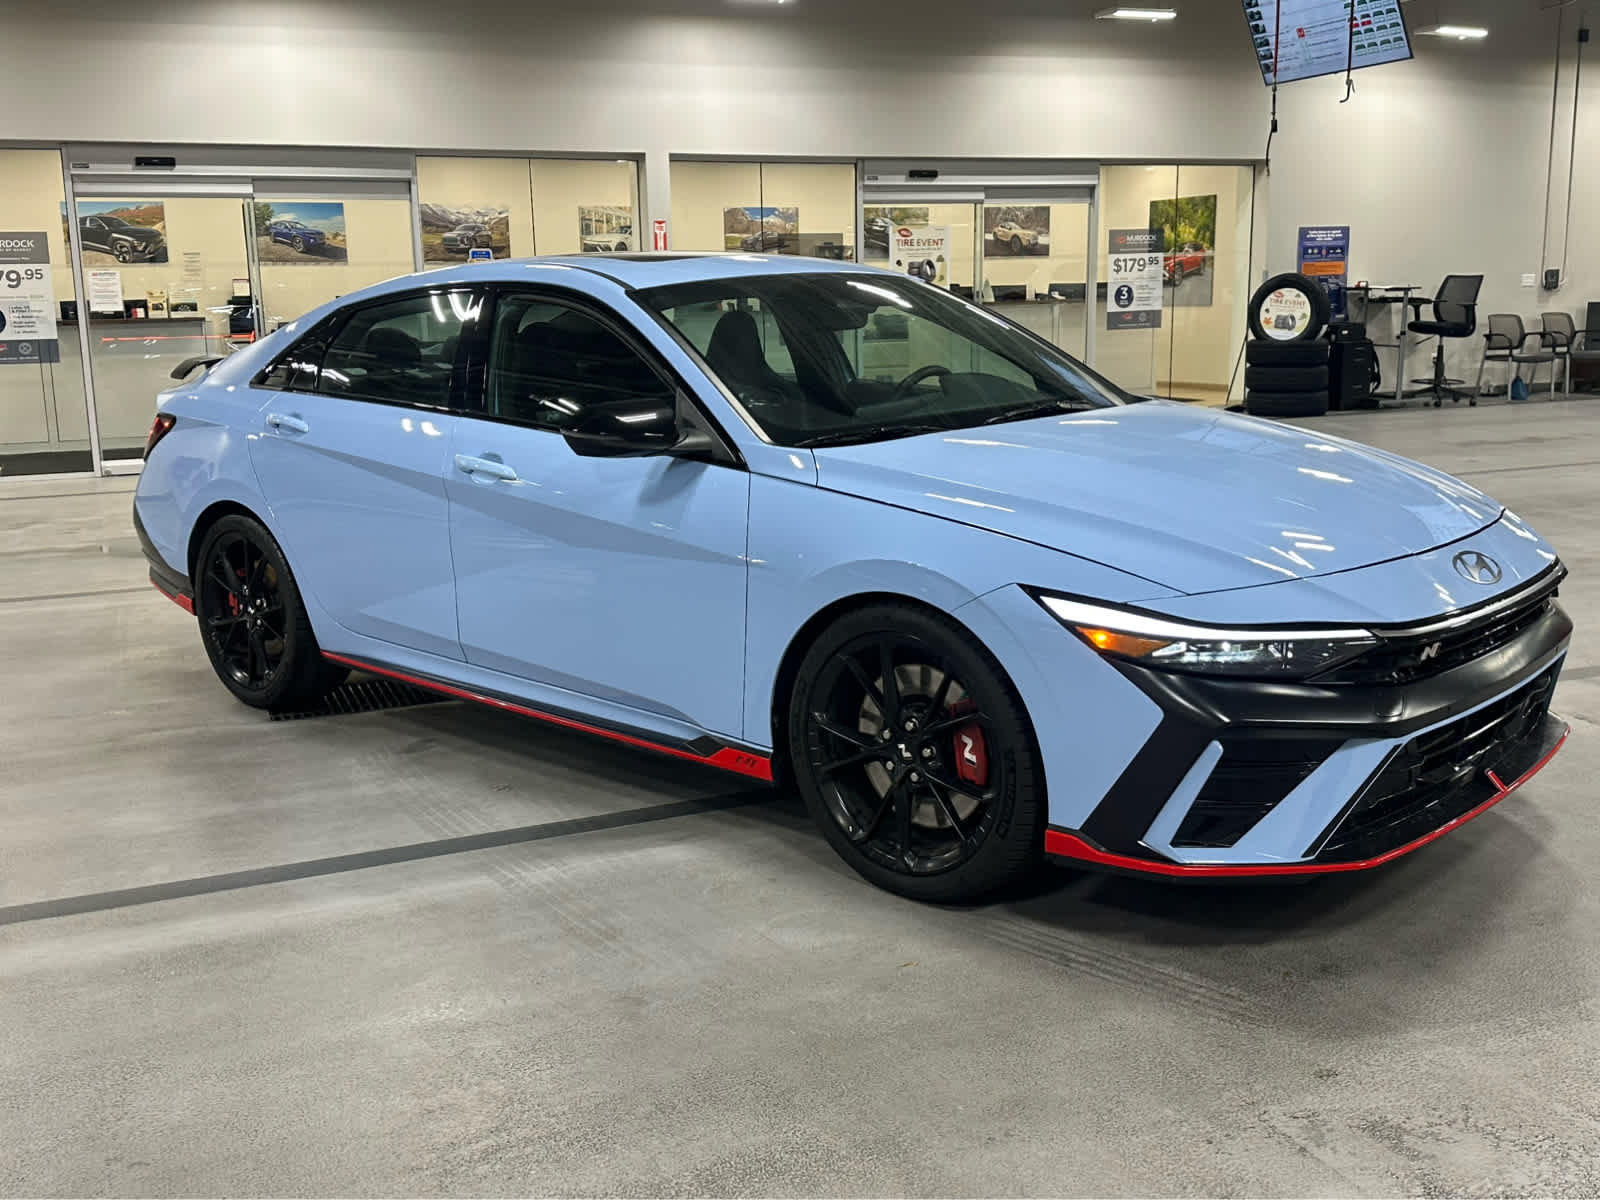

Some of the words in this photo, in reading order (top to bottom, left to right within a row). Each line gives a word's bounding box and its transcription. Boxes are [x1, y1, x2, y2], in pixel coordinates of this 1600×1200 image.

[896, 238, 915, 247] TIRE
[917, 238, 945, 247] EVENT
[1113, 256, 1160, 274] $179.95
[1120, 286, 1129, 300] 3
[1420, 641, 1441, 661] N
[961, 734, 977, 768] N
